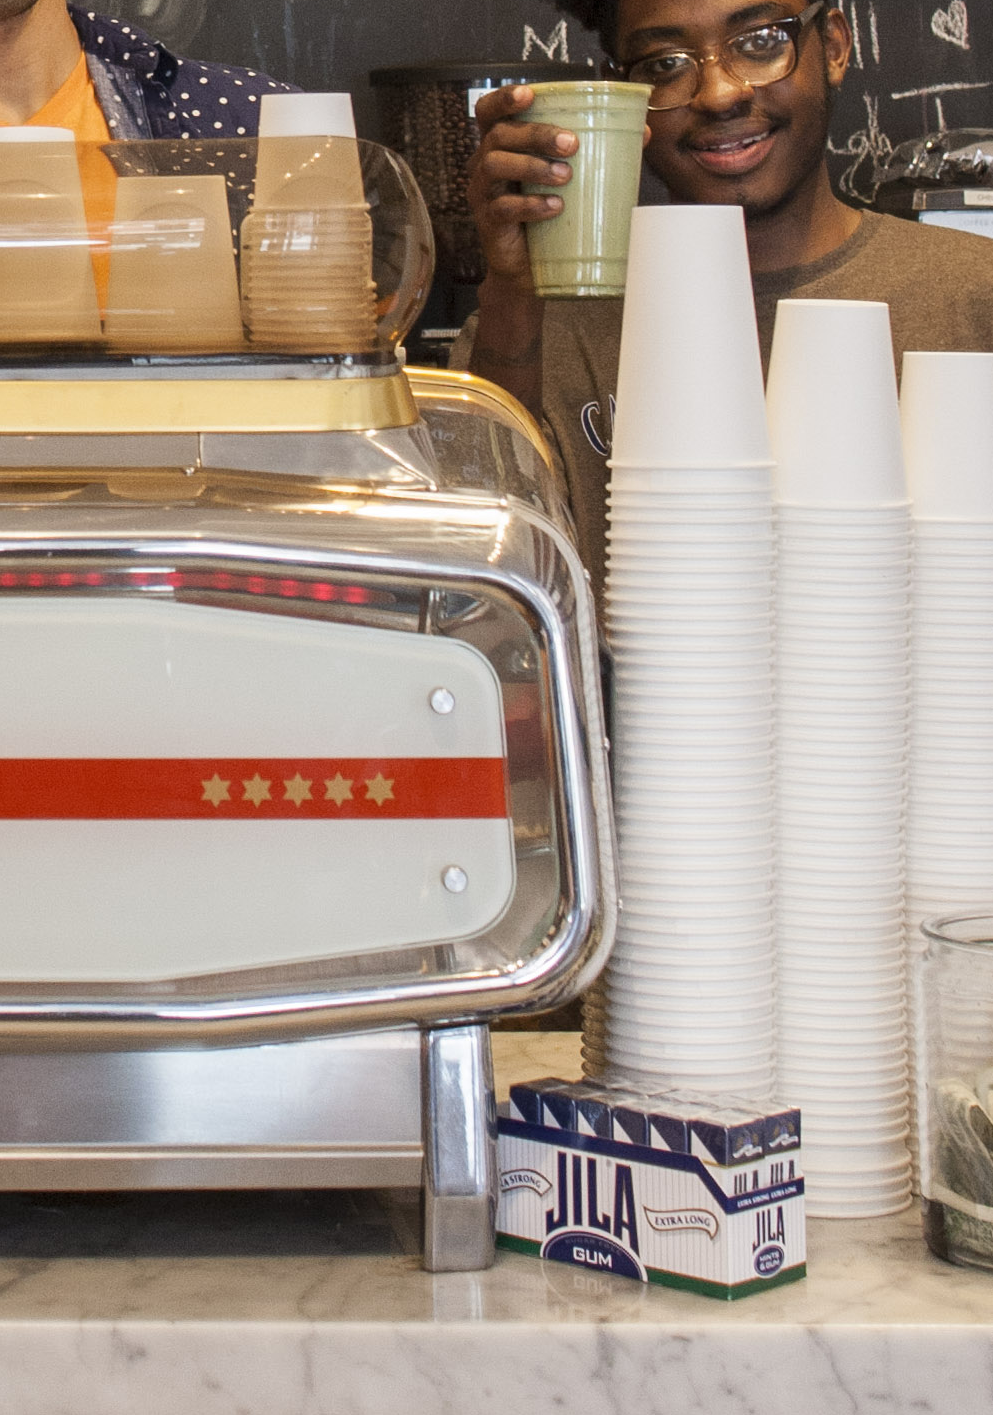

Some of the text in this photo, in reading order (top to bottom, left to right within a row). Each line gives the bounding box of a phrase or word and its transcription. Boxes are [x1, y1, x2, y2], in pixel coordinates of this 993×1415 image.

[545, 1150, 640, 1259] JILA
[655, 1215, 710, 1227] EXTRA LONG
[752, 1205, 786, 1253] JILA
[572, 1246, 613, 1269] GUM
